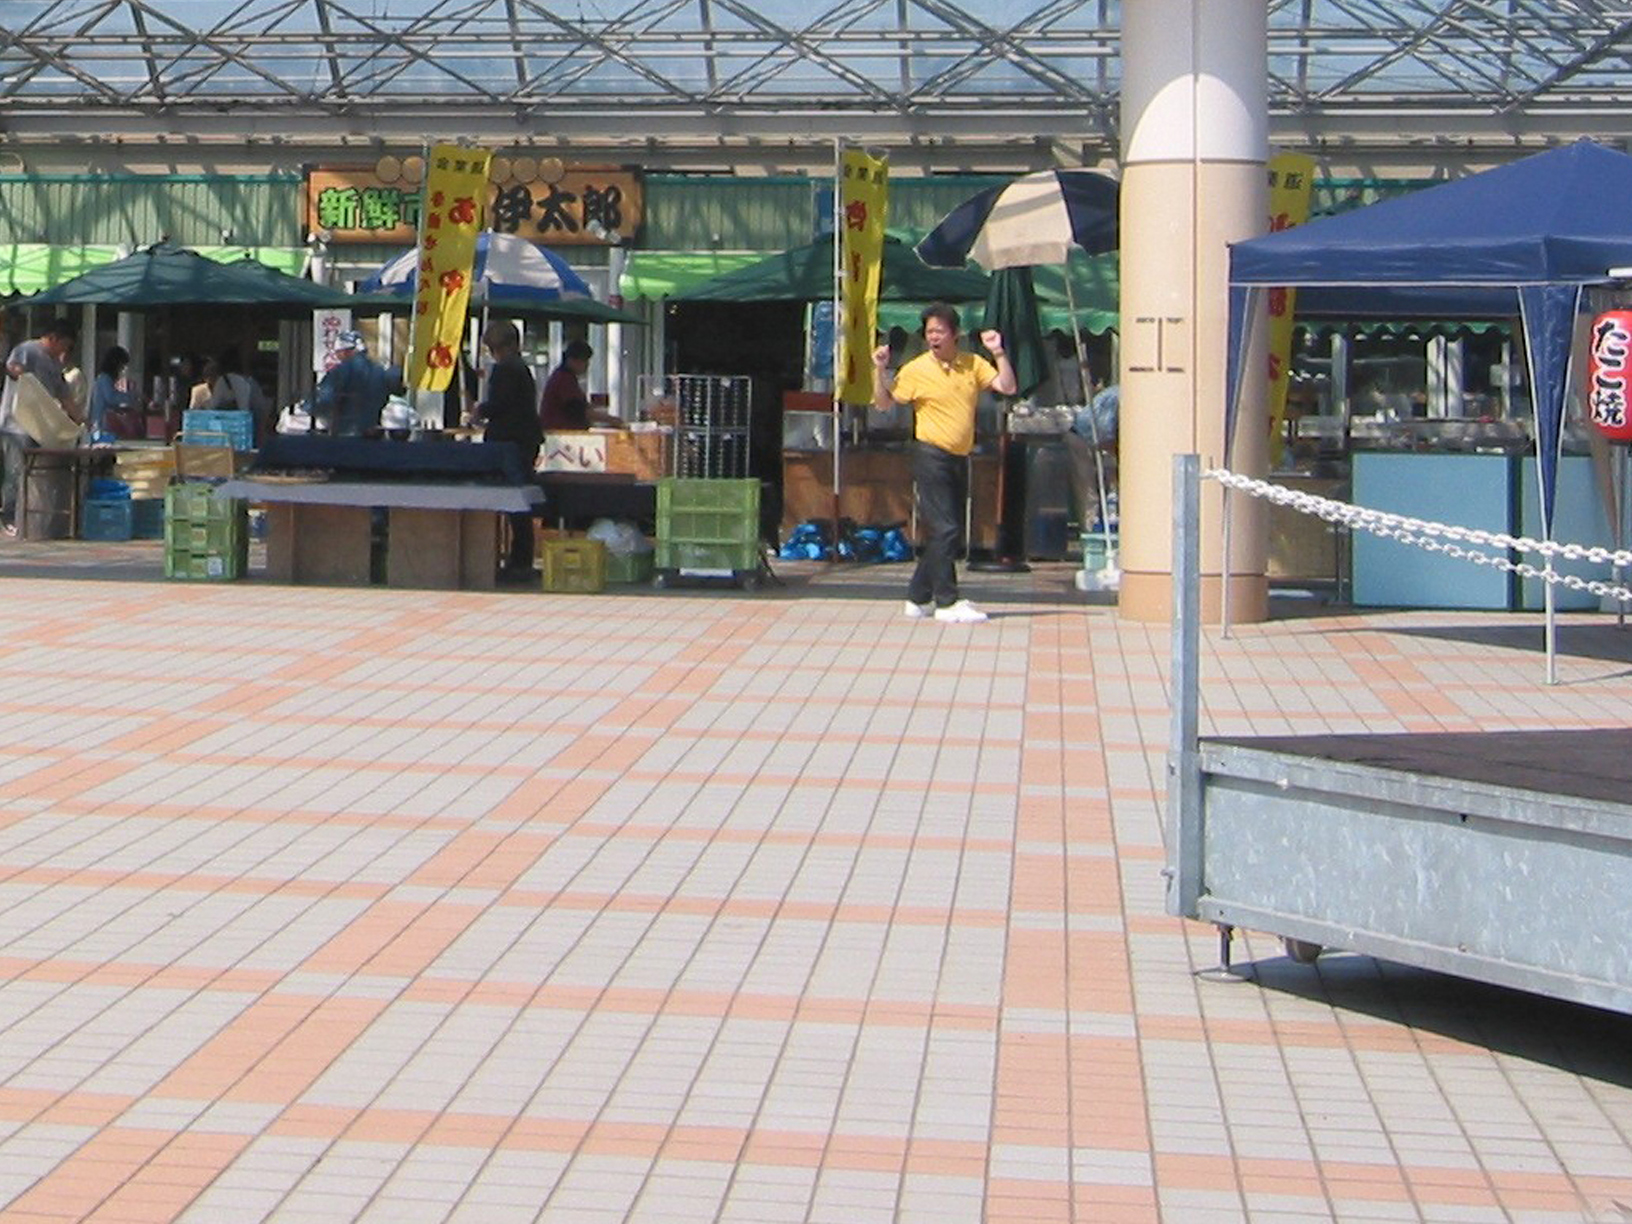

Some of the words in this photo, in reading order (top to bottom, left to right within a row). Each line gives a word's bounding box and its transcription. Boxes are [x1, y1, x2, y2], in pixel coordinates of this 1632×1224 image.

[493, 184, 622, 233] 伊太郎
[1594, 320, 1628, 425] たこ焼
